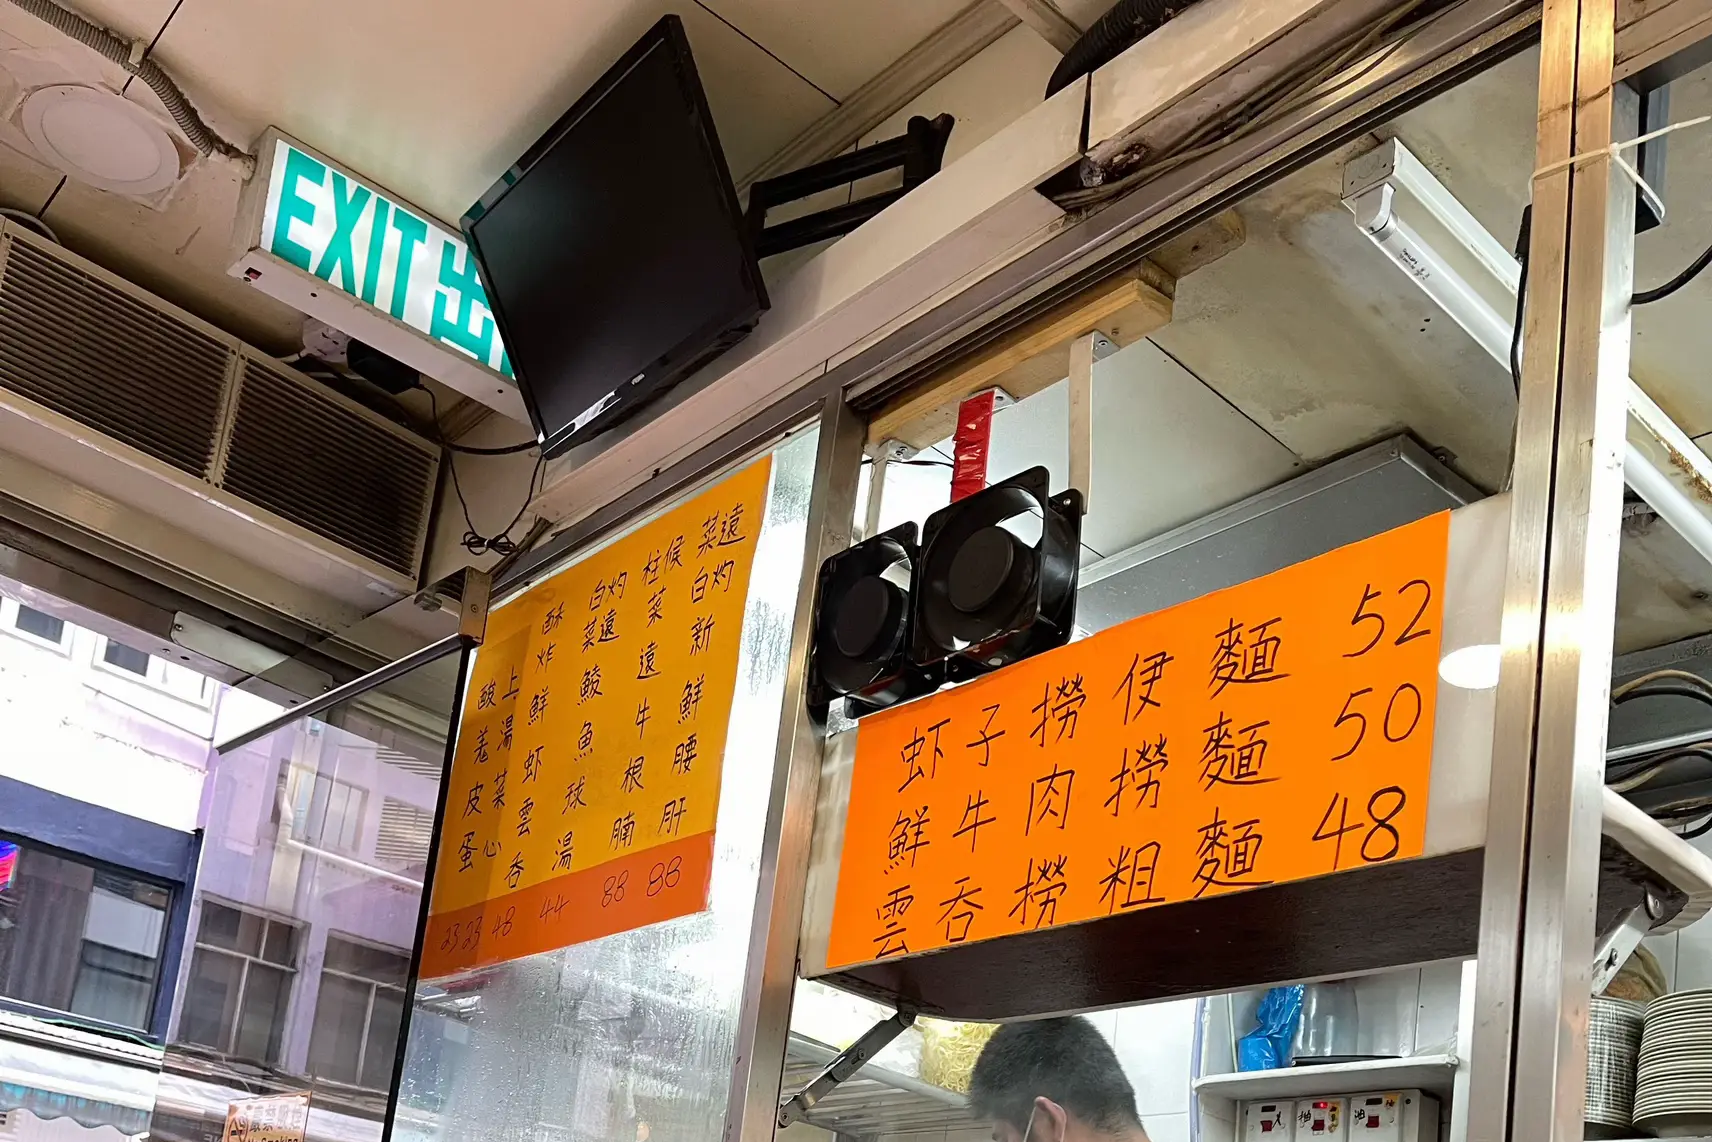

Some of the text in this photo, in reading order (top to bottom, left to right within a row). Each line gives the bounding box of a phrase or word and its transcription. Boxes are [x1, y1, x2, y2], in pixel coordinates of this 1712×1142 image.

[271, 147, 428, 321] EXIT
[430, 240, 516, 381] 出
[1342, 579, 1432, 659] 52
[1331, 683, 1422, 762] 50
[1311, 785, 1407, 871] 48
[540, 894, 570, 924] 44
[601, 870, 629, 908] 88
[646, 855, 682, 898] 88
[492, 905, 516, 938] 48
